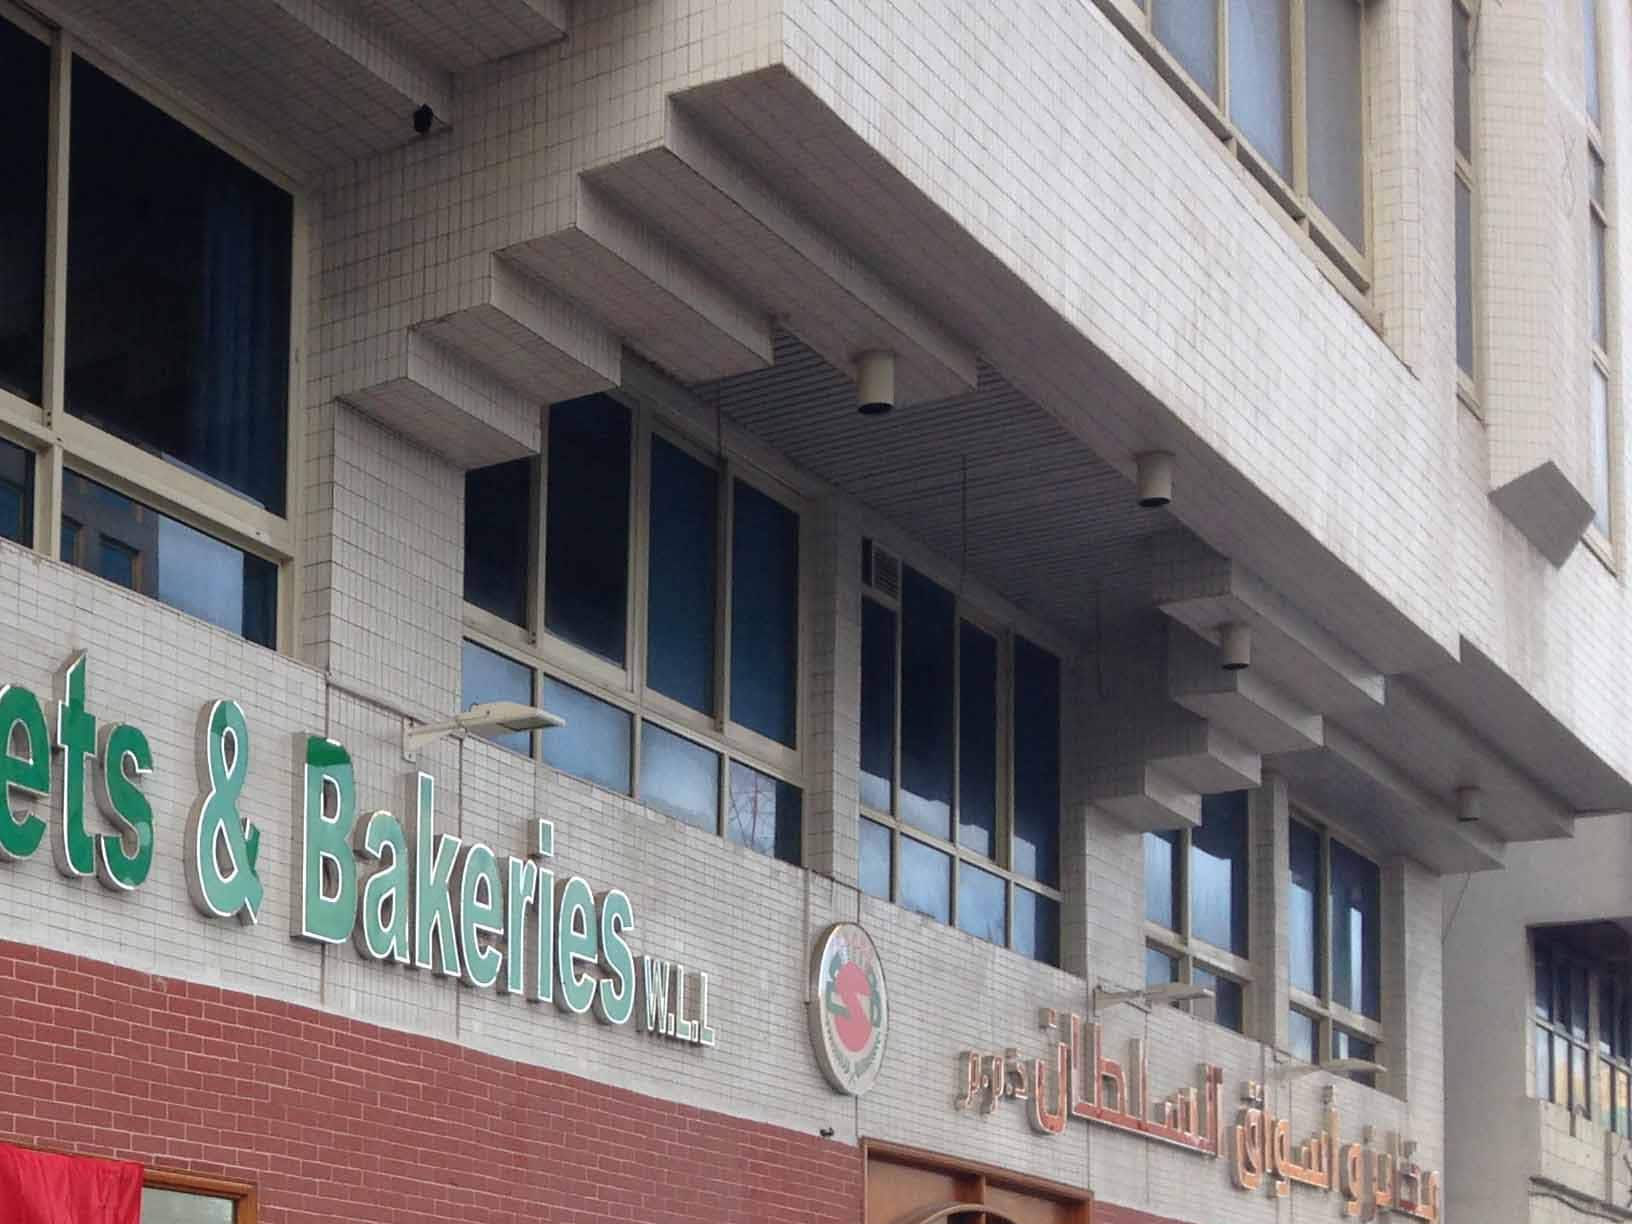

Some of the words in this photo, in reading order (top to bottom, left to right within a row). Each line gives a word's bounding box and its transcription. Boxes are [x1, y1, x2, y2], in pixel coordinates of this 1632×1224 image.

[185, 699, 264, 926] &
[290, 732, 636, 1026] Bakeries
[1027, 1006, 1225, 1162] السلطان
